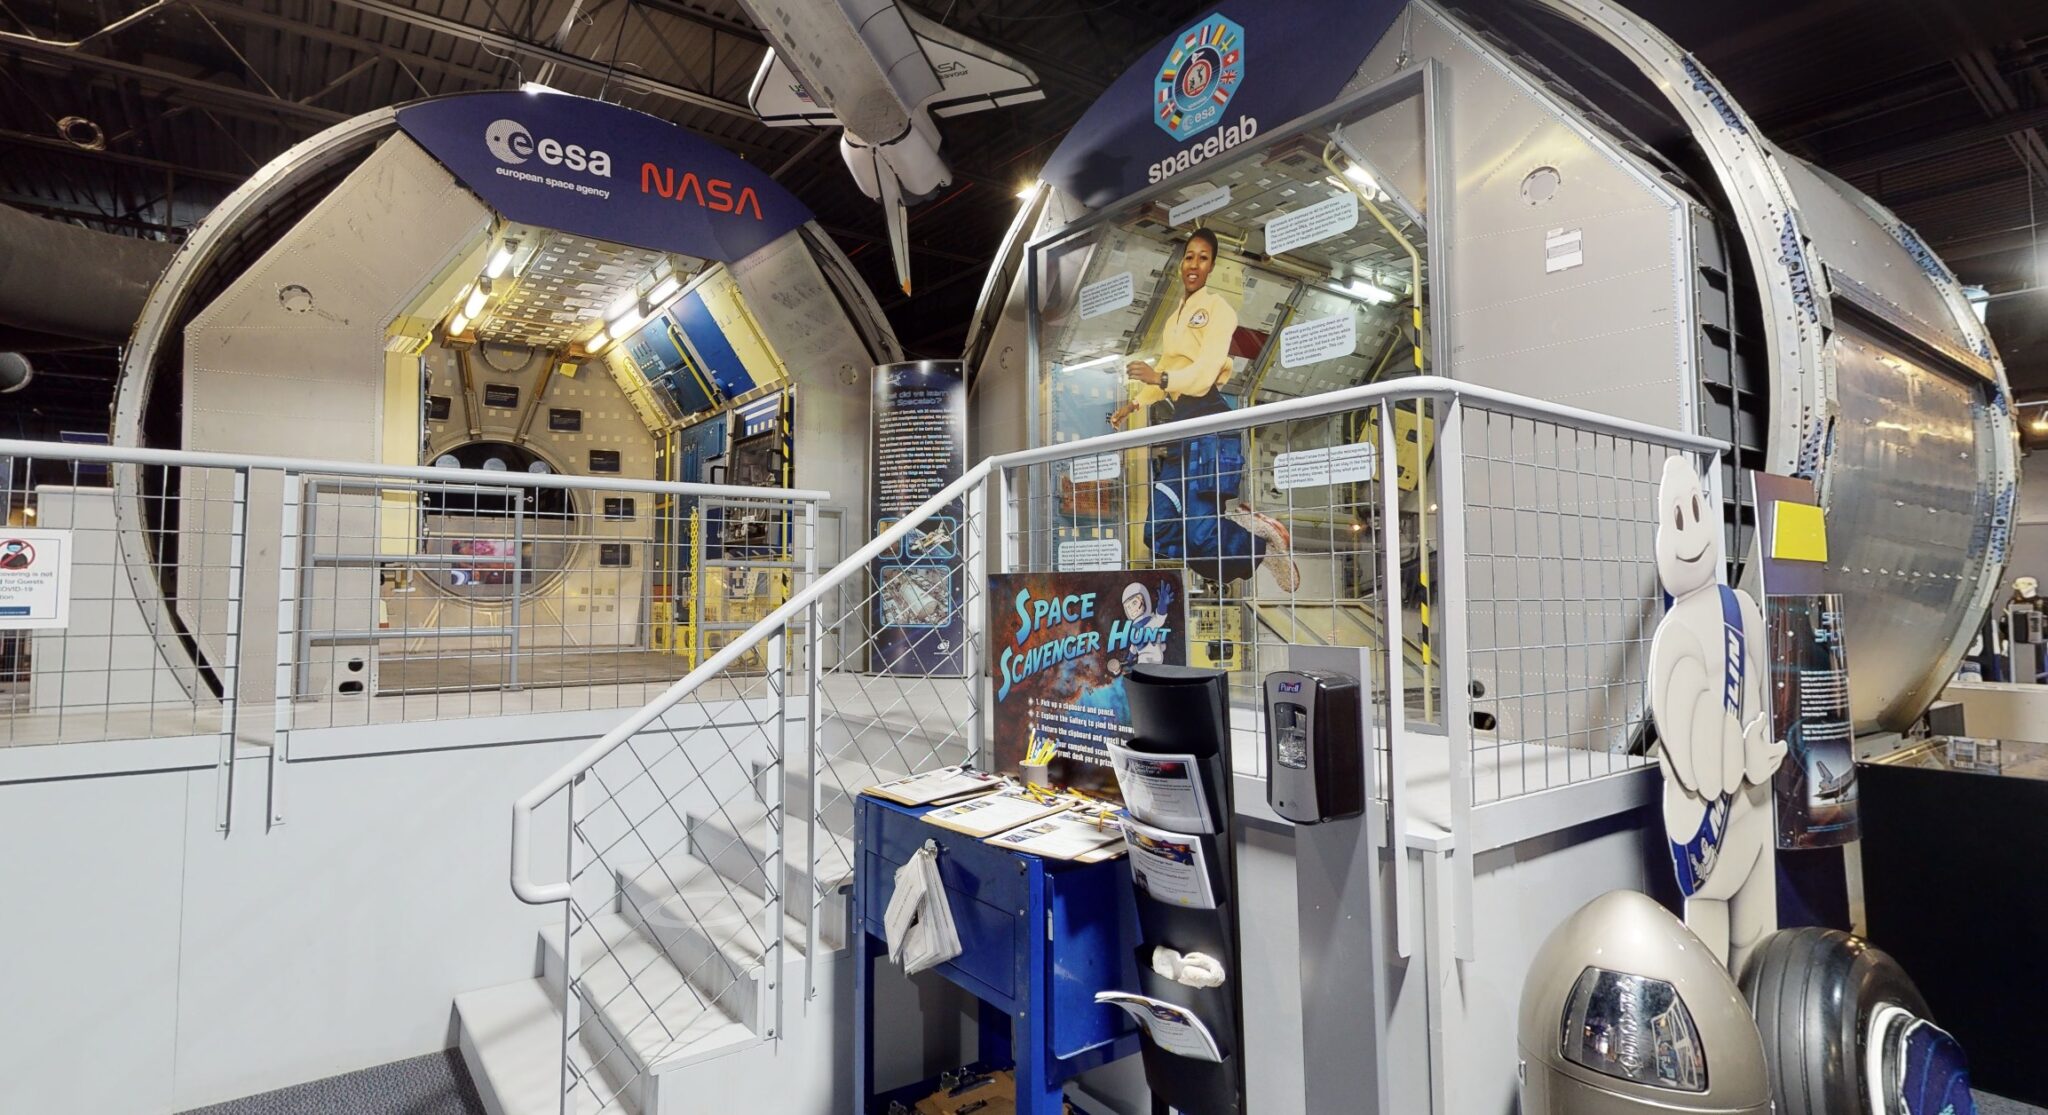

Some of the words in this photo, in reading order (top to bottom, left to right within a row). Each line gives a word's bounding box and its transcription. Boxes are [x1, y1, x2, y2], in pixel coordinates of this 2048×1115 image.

[537, 138, 612, 178] esa
[1148, 114, 1258, 184] spacelab
[496, 166, 544, 184] european
[546, 178, 575, 194] space
[576, 184, 610, 200] agency
[641, 163, 764, 220] NASA
[1016, 588, 1096, 646] SPACE
[998, 631, 1100, 703] SCAVENGER
[1107, 620, 1171, 654] HUNT
[1280, 682, 1300, 692] Purell
[1041, 712, 1058, 721] Explore
[1069, 716, 1086, 727] Gallery
[1095, 721, 1106, 729] find
[1108, 722, 1117, 730] the
[1118, 725, 1135, 734] answ
[1063, 703, 1086, 713] clipboard
[1098, 708, 1115, 717] pencil.
[1058, 727, 1067, 735] the
[1068, 728, 1091, 740] clipboard
[1092, 732, 1102, 742] and
[1068, 742, 1093, 754] completed
[1095, 748, 1110, 757] scave
[1072, 752, 1083, 760] desk
[1084, 755, 1093, 764] for
